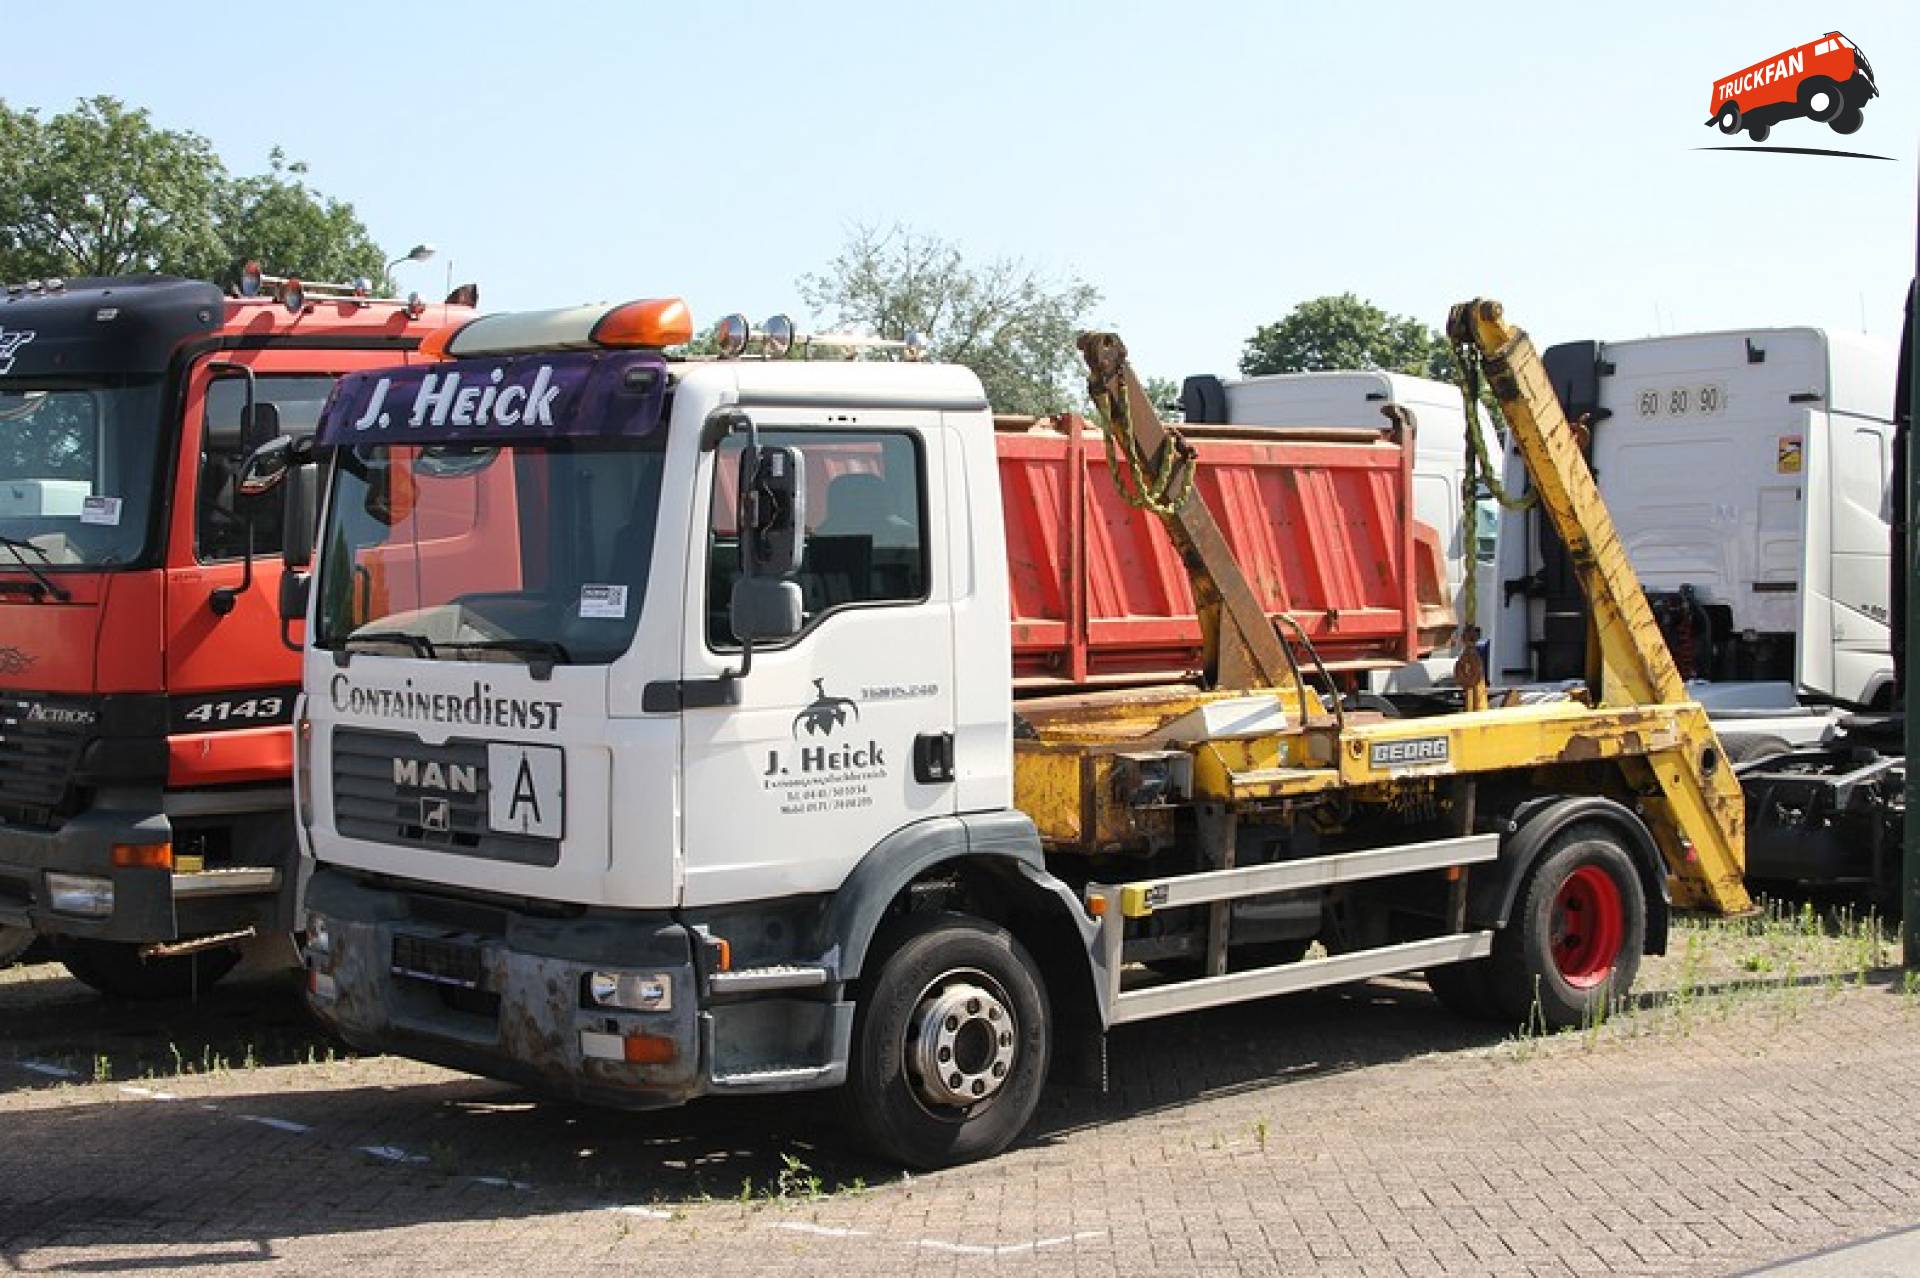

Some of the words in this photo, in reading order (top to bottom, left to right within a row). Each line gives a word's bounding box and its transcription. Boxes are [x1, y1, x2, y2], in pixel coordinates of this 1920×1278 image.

[355, 378, 390, 431] J.
[1641, 392, 1658, 415] 60
[1670, 389, 1687, 413] 80
[1700, 387, 1718, 411] 90
[184, 697, 283, 722] 4143
[763, 750, 789, 776] J.
[1373, 740, 1447, 761] GEORG
[393, 757, 477, 793] MAN
[508, 751, 542, 824] A
